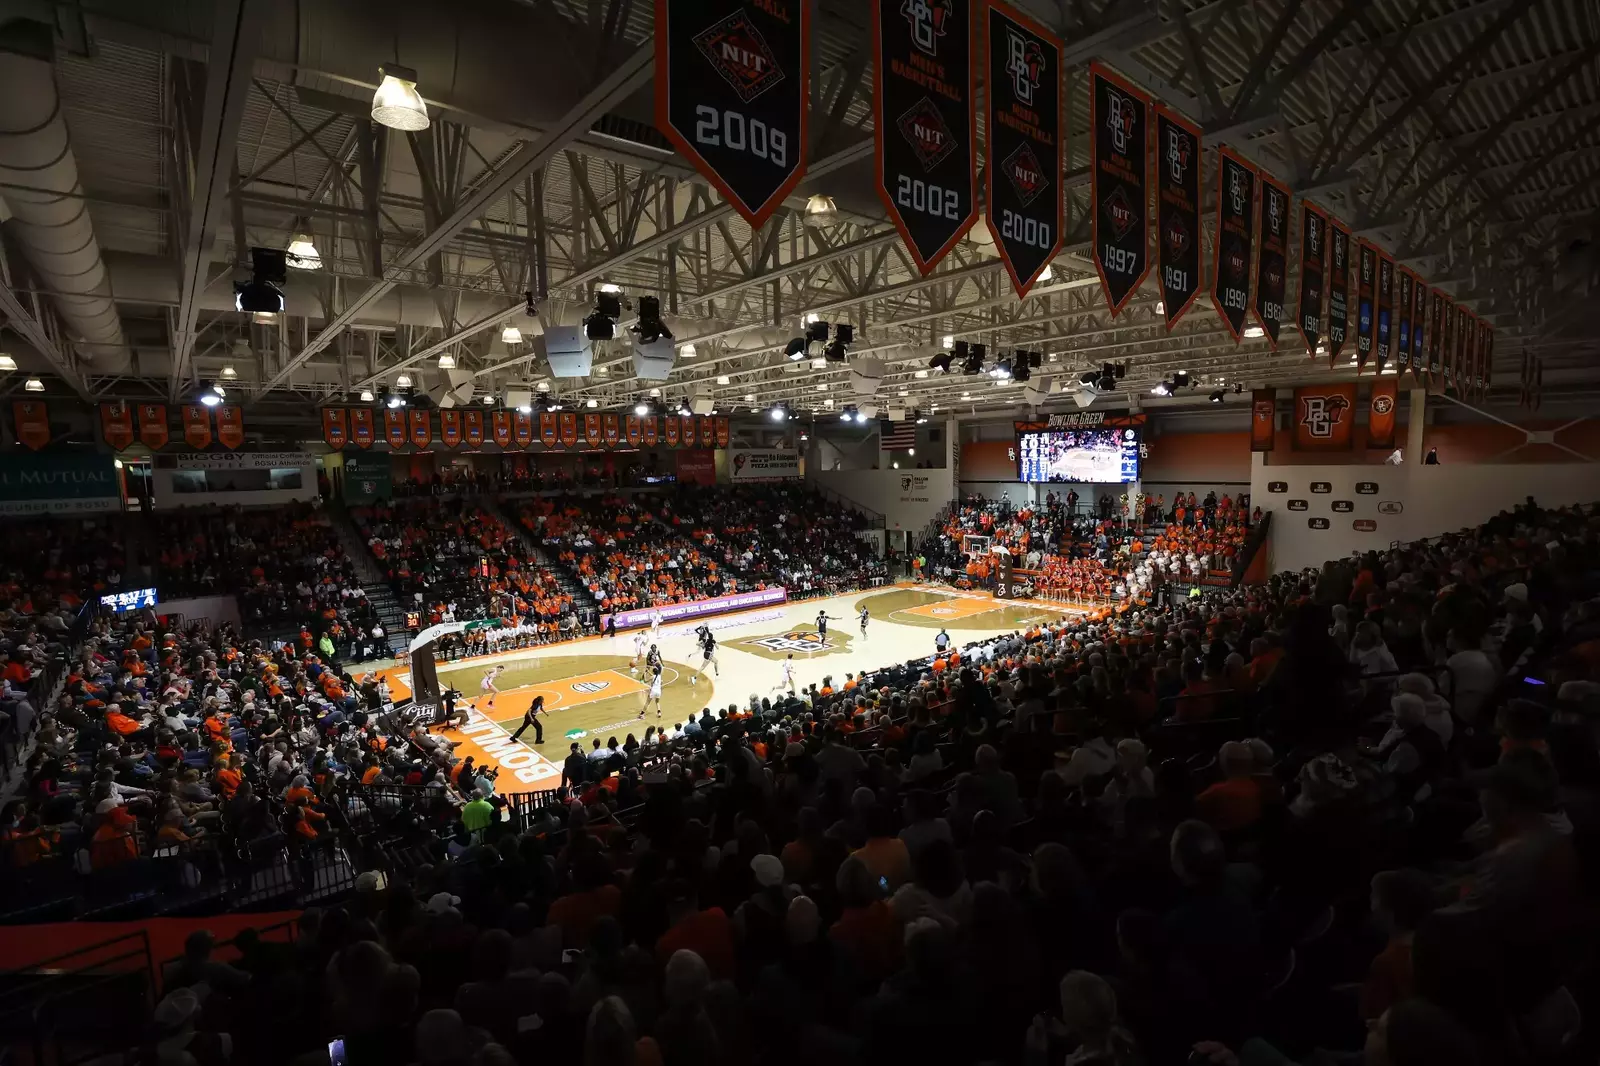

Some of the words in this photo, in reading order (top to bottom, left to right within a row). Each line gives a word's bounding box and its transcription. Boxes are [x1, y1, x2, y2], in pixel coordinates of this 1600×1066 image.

[721, 41, 766, 72] NIT
[891, 57, 962, 102] BASKETBALL
[695, 104, 787, 168] 2009
[914, 123, 943, 146] NIT
[1015, 164, 1038, 184] NIT
[897, 174, 960, 221] 2002
[1112, 203, 1131, 221] NIT
[1002, 209, 1051, 250] 2000
[1170, 229, 1185, 245] NIT
[1104, 243, 1137, 276] 1997
[1164, 265, 1188, 294] 1991
[1225, 287, 1246, 311] 1990
[1048, 413, 1080, 427] BOWLING
[1079, 411, 1105, 425] GREEN
[178, 453, 246, 461] BIGGBY
[20, 468, 112, 484] MUTUAL
[75, 500, 110, 509] BGSU
[452, 705, 562, 784] BOWLIN
